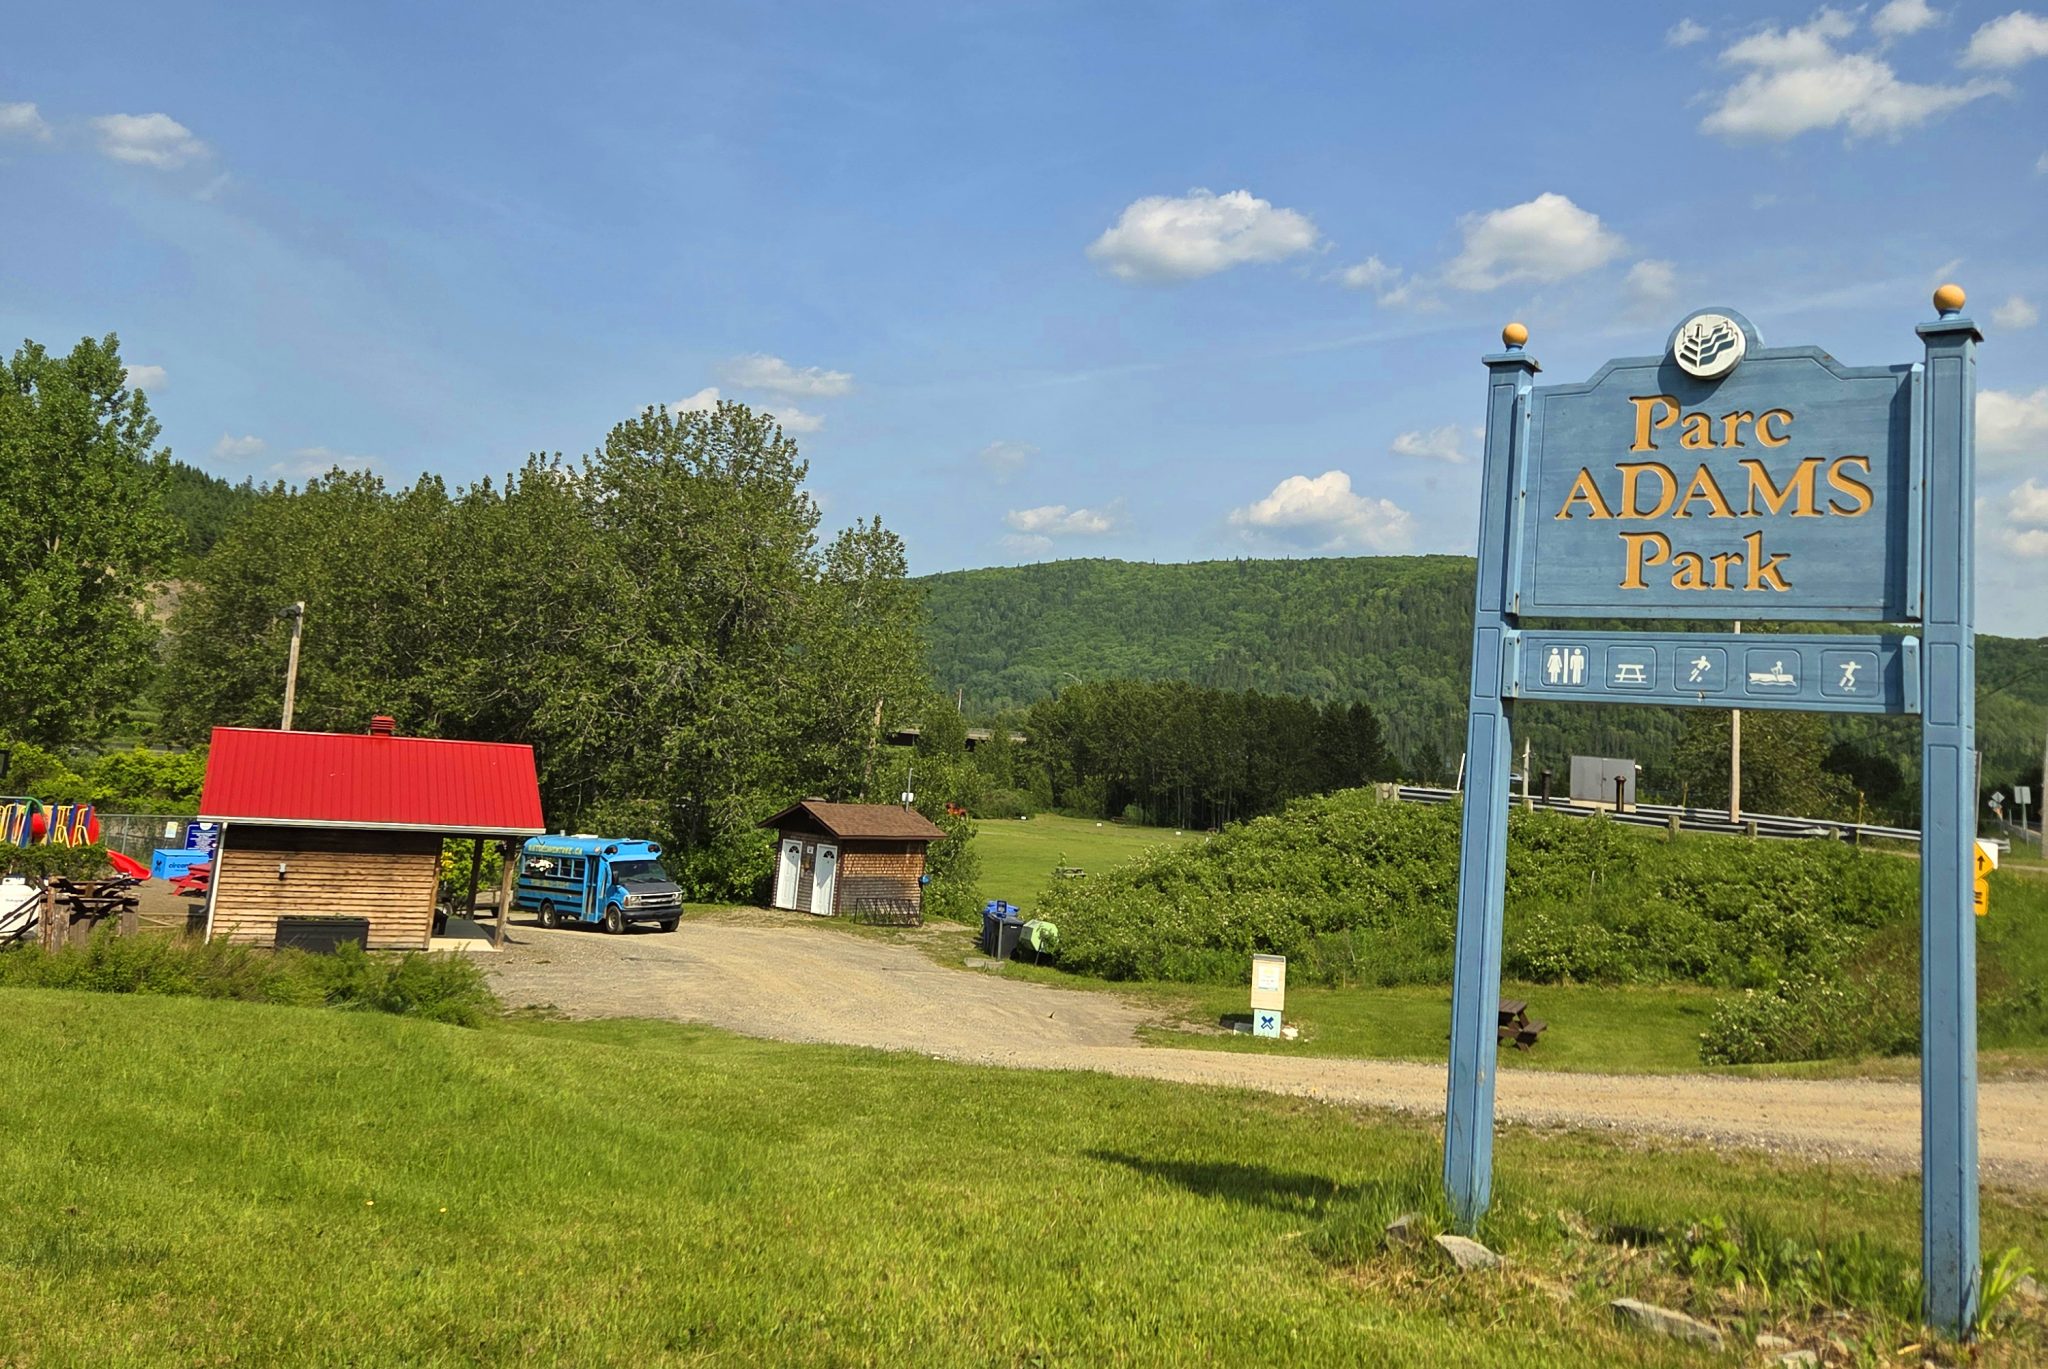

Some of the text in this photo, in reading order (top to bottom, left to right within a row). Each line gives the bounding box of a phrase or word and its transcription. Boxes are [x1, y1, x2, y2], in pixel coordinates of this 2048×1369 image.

[1629, 395, 1794, 452] Parc
[1555, 456, 1873, 520] ADAMS
[1618, 530, 1792, 592] Park
